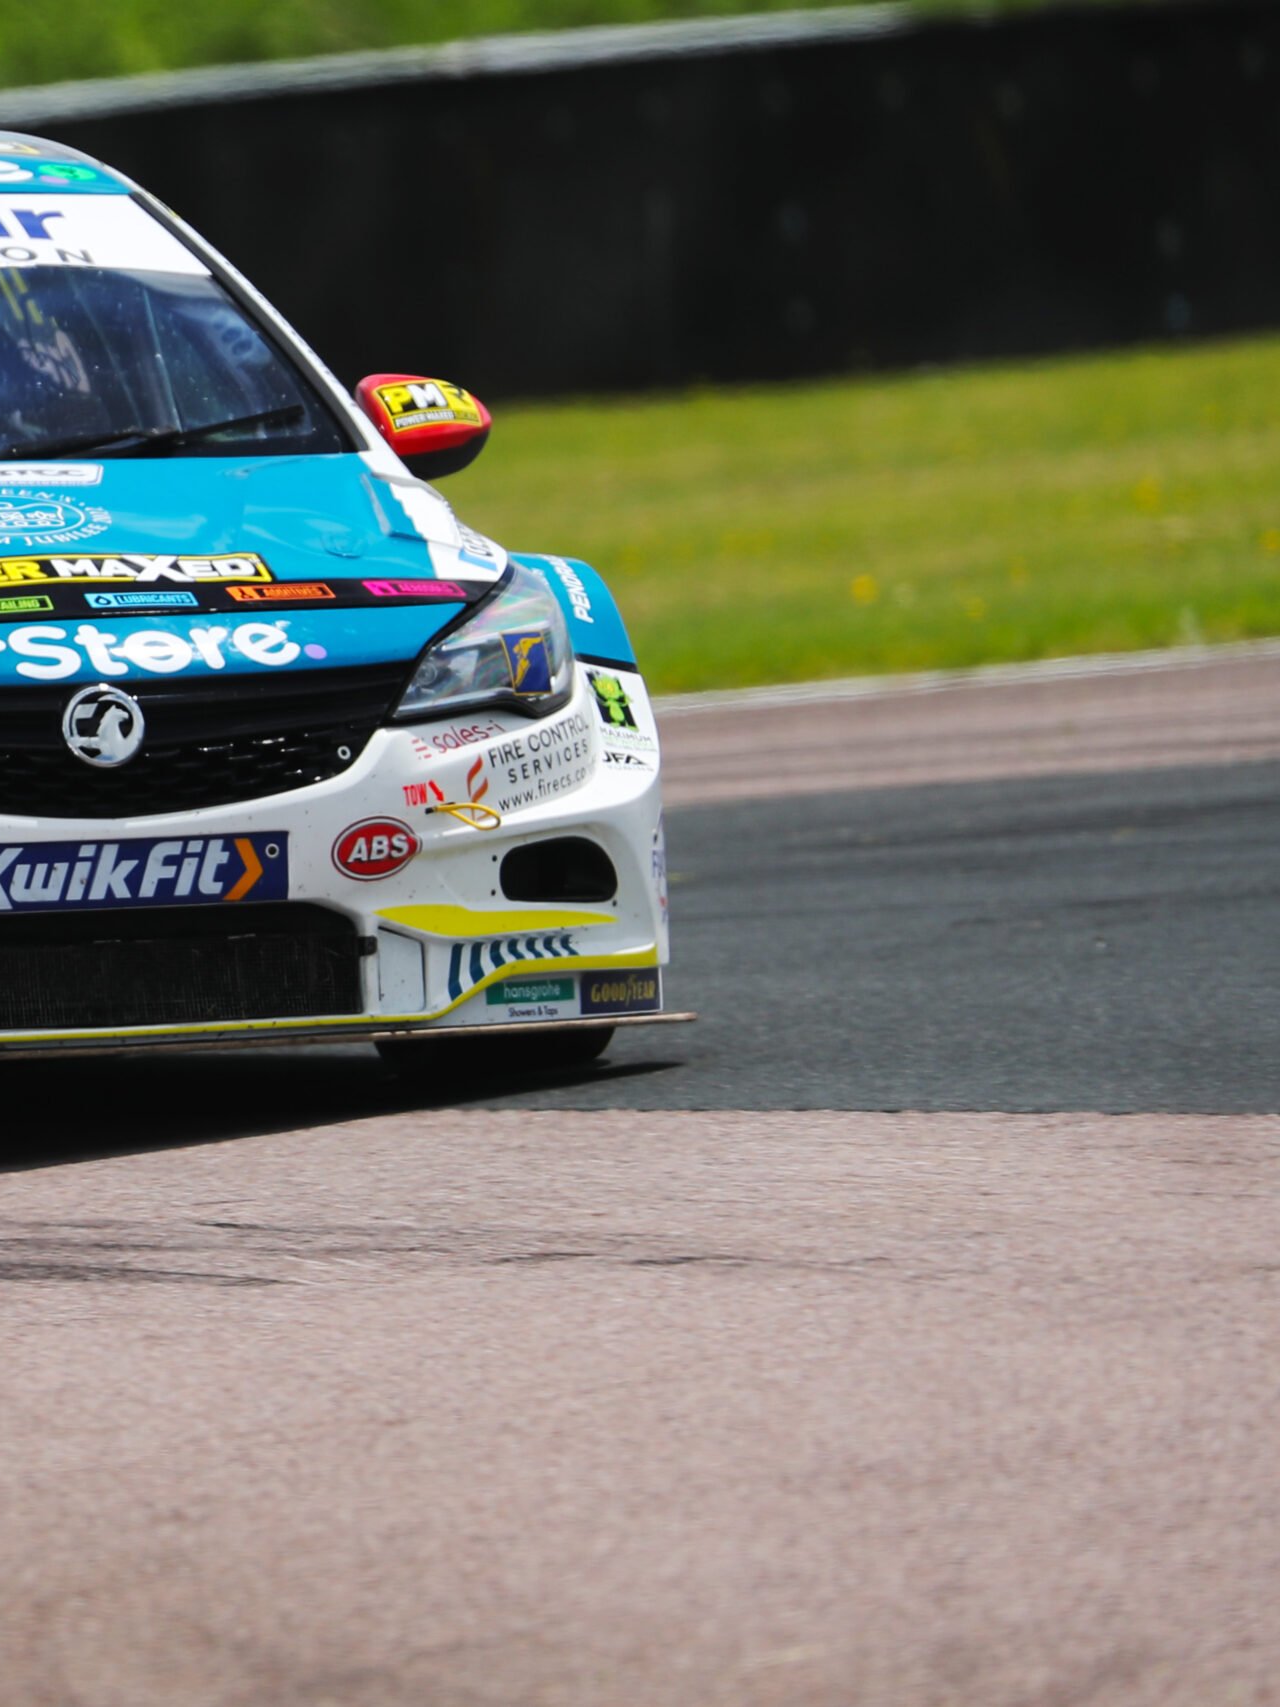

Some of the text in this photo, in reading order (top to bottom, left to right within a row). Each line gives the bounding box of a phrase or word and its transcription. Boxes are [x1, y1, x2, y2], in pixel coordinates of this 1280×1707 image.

[52, 555, 255, 582] MAXED
[116, 593, 192, 605] LUBRICANTS
[488, 739, 526, 769] FIRE
[508, 738, 589, 784] SERVICES
[403, 783, 429, 807] TOW
[346, 834, 411, 868] ABS
[504, 983, 560, 1000] hansgrohe
[509, 1006, 534, 1018] Showers
